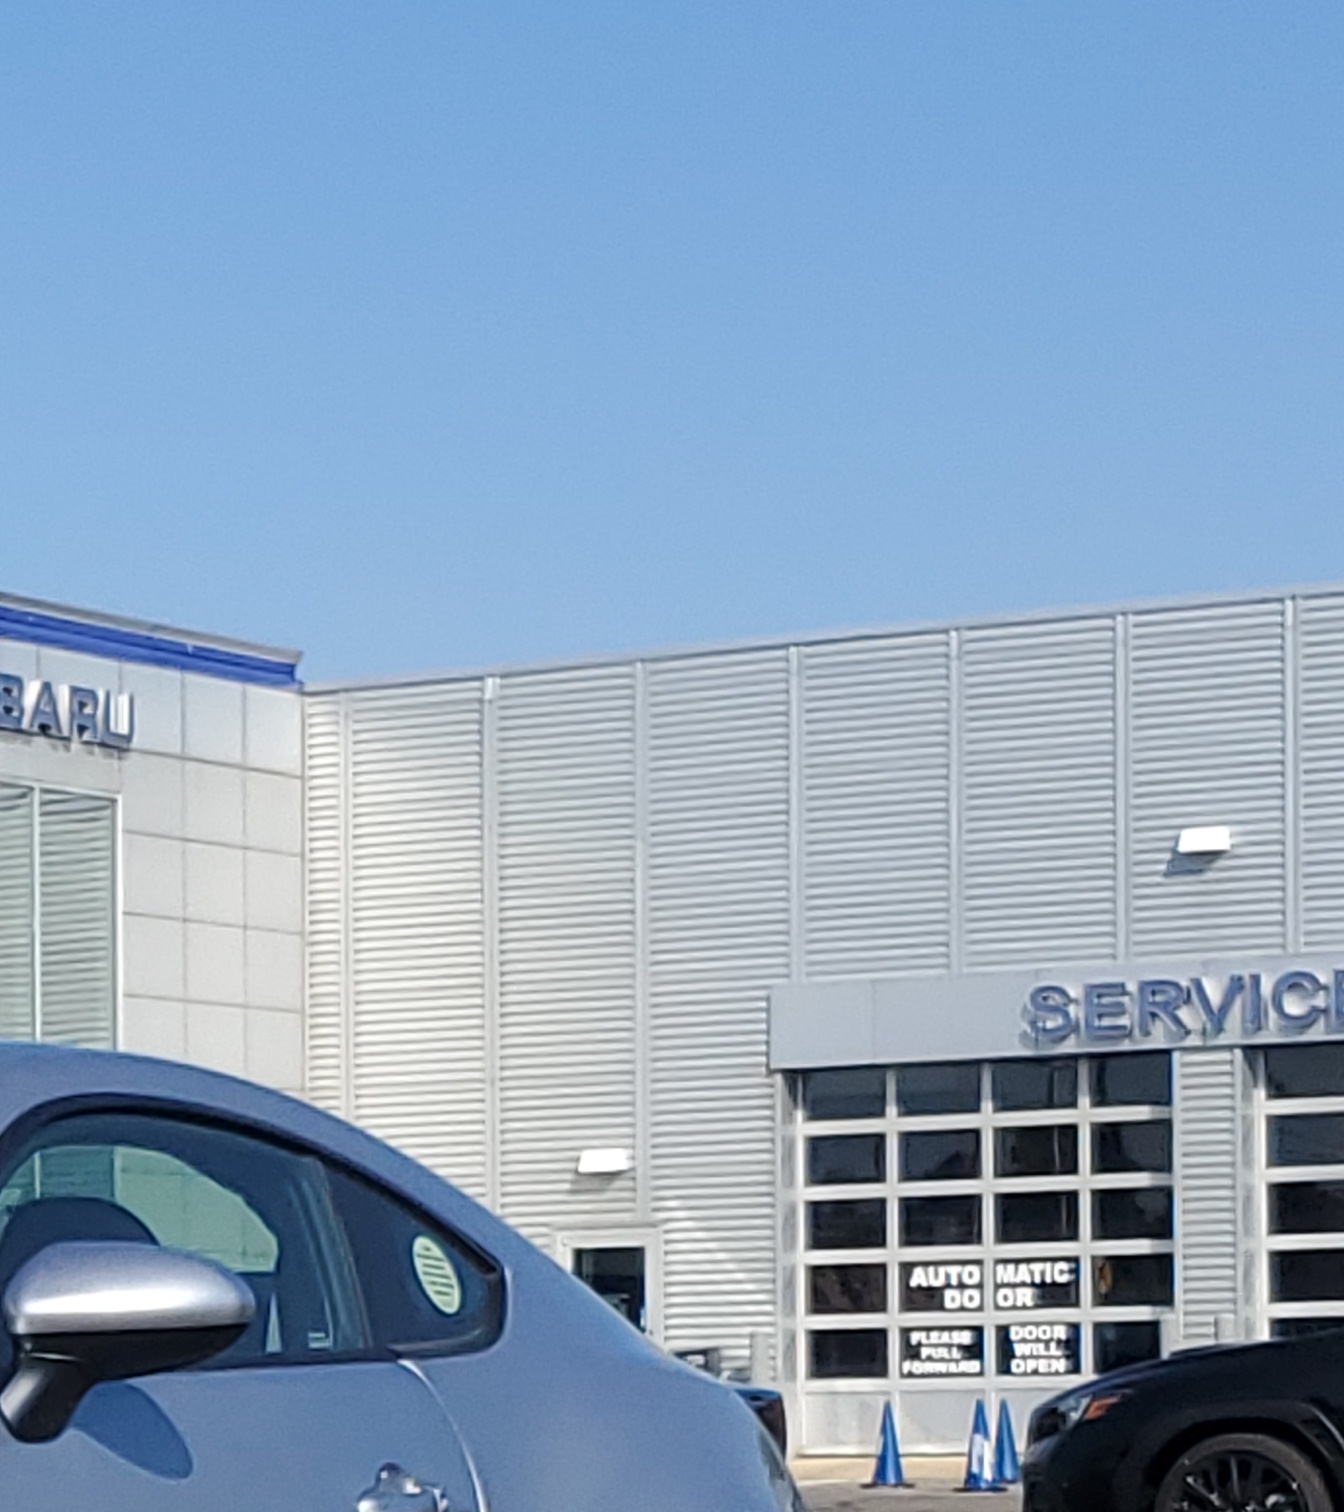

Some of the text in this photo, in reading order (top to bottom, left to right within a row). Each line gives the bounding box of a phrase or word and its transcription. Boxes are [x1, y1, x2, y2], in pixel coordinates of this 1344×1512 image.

[1029, 969, 1344, 1043] SERVIC
[909, 1330, 973, 1345] PLEASE
[1009, 1325, 1067, 1341] DOOR
[1012, 1342, 1063, 1357] WILL
[1010, 1358, 1066, 1373] OPEN
